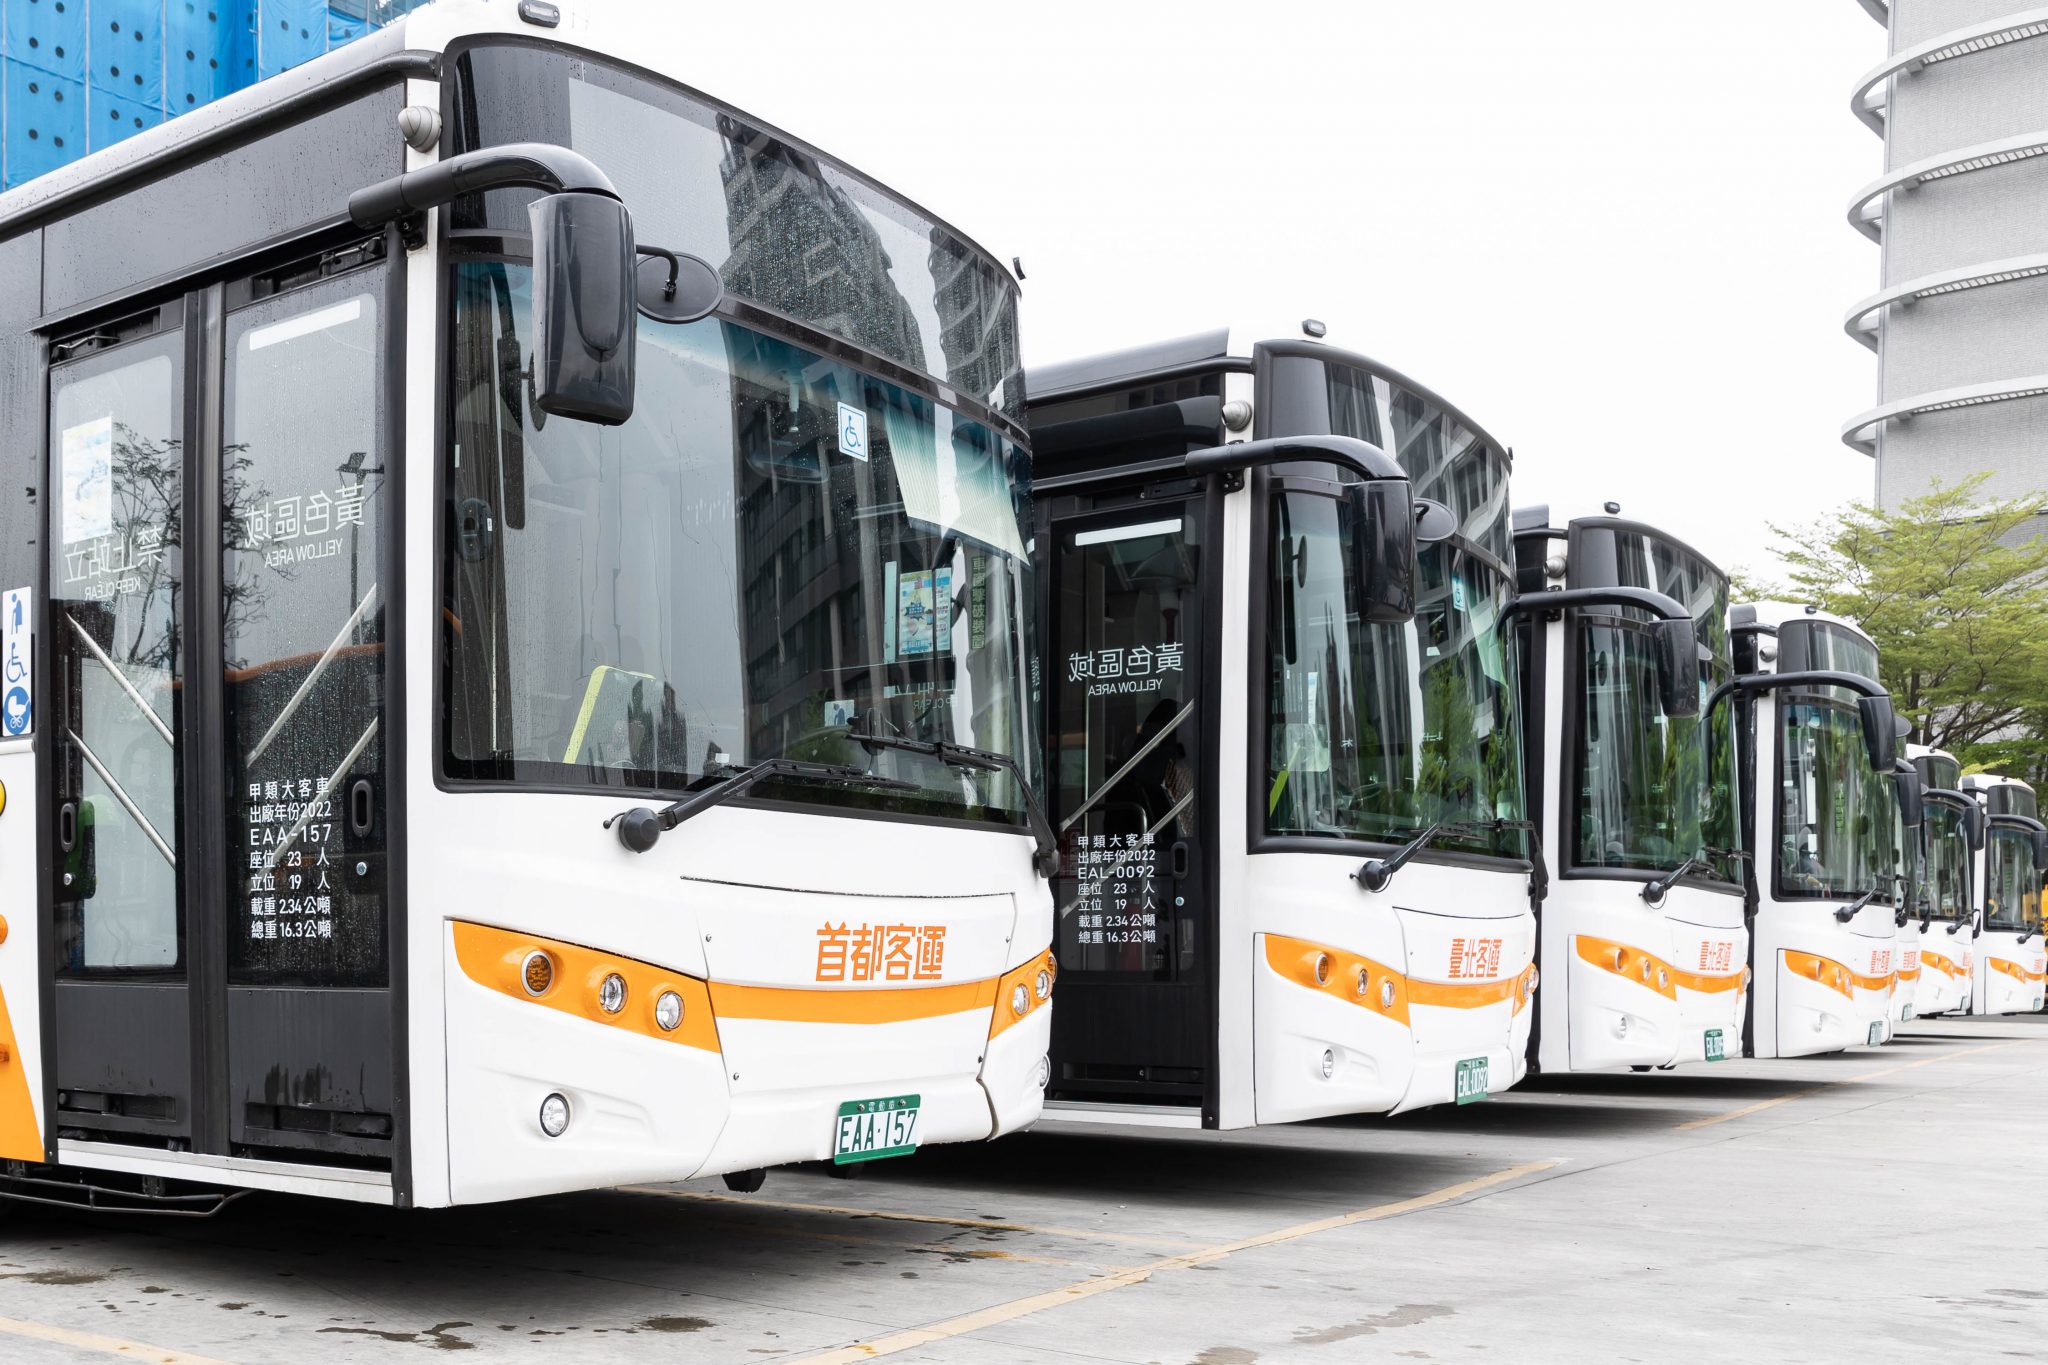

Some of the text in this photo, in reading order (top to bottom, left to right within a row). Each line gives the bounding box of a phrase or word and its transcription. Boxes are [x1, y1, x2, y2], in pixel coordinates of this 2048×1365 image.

[249, 776, 330, 801] 甲類大客車
[250, 823, 332, 846] EAA-157
[1077, 833, 1156, 849] 甲類大客車
[250, 846, 330, 869] 座位 23 人
[250, 870, 331, 892] 立位 19 人
[1078, 866, 1155, 880] EAL-0092
[1078, 880, 1156, 896] 座位 23 人
[1078, 896, 1156, 911] 立位 19 人
[815, 921, 947, 981] 首都客運
[1448, 938, 1503, 978] 臺北客運
